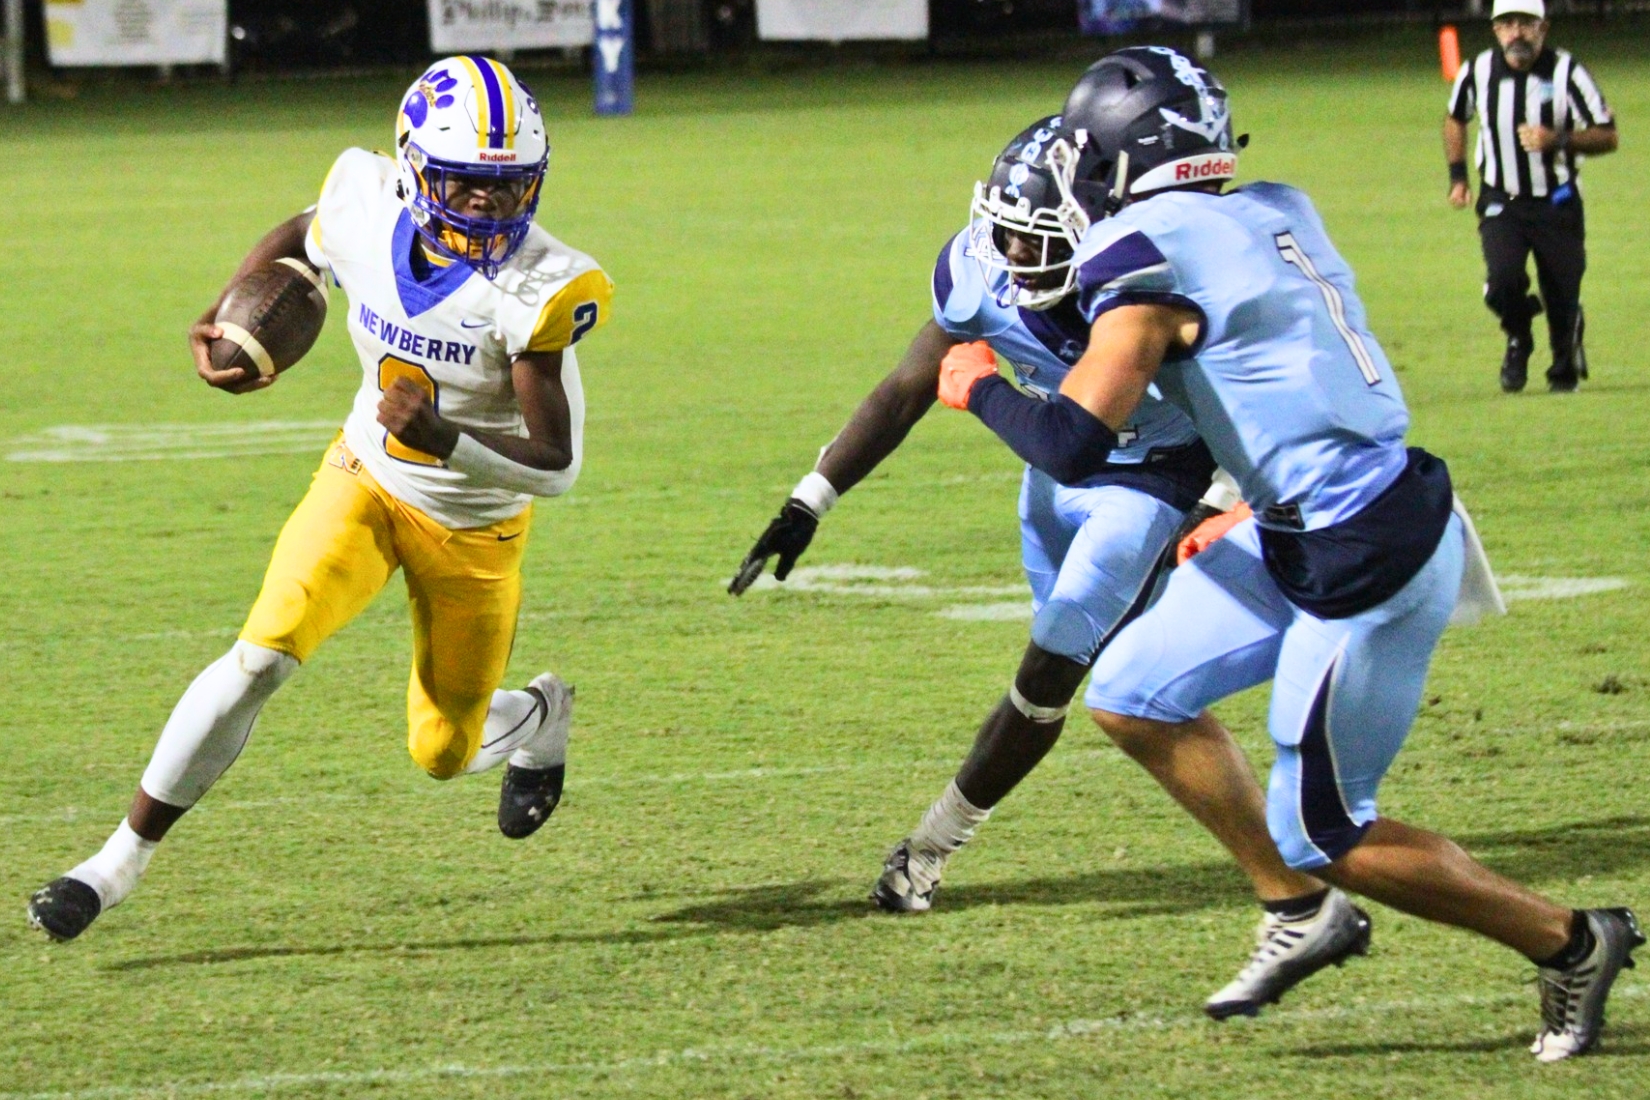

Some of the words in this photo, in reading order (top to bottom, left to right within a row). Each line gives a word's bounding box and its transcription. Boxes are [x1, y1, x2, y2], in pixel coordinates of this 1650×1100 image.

[479, 151, 517, 165] Riddell
[1174, 158, 1236, 180] Riddel
[569, 299, 599, 345] 2
[1274, 231, 1381, 386] 1
[359, 303, 476, 366] NEWBERRY
